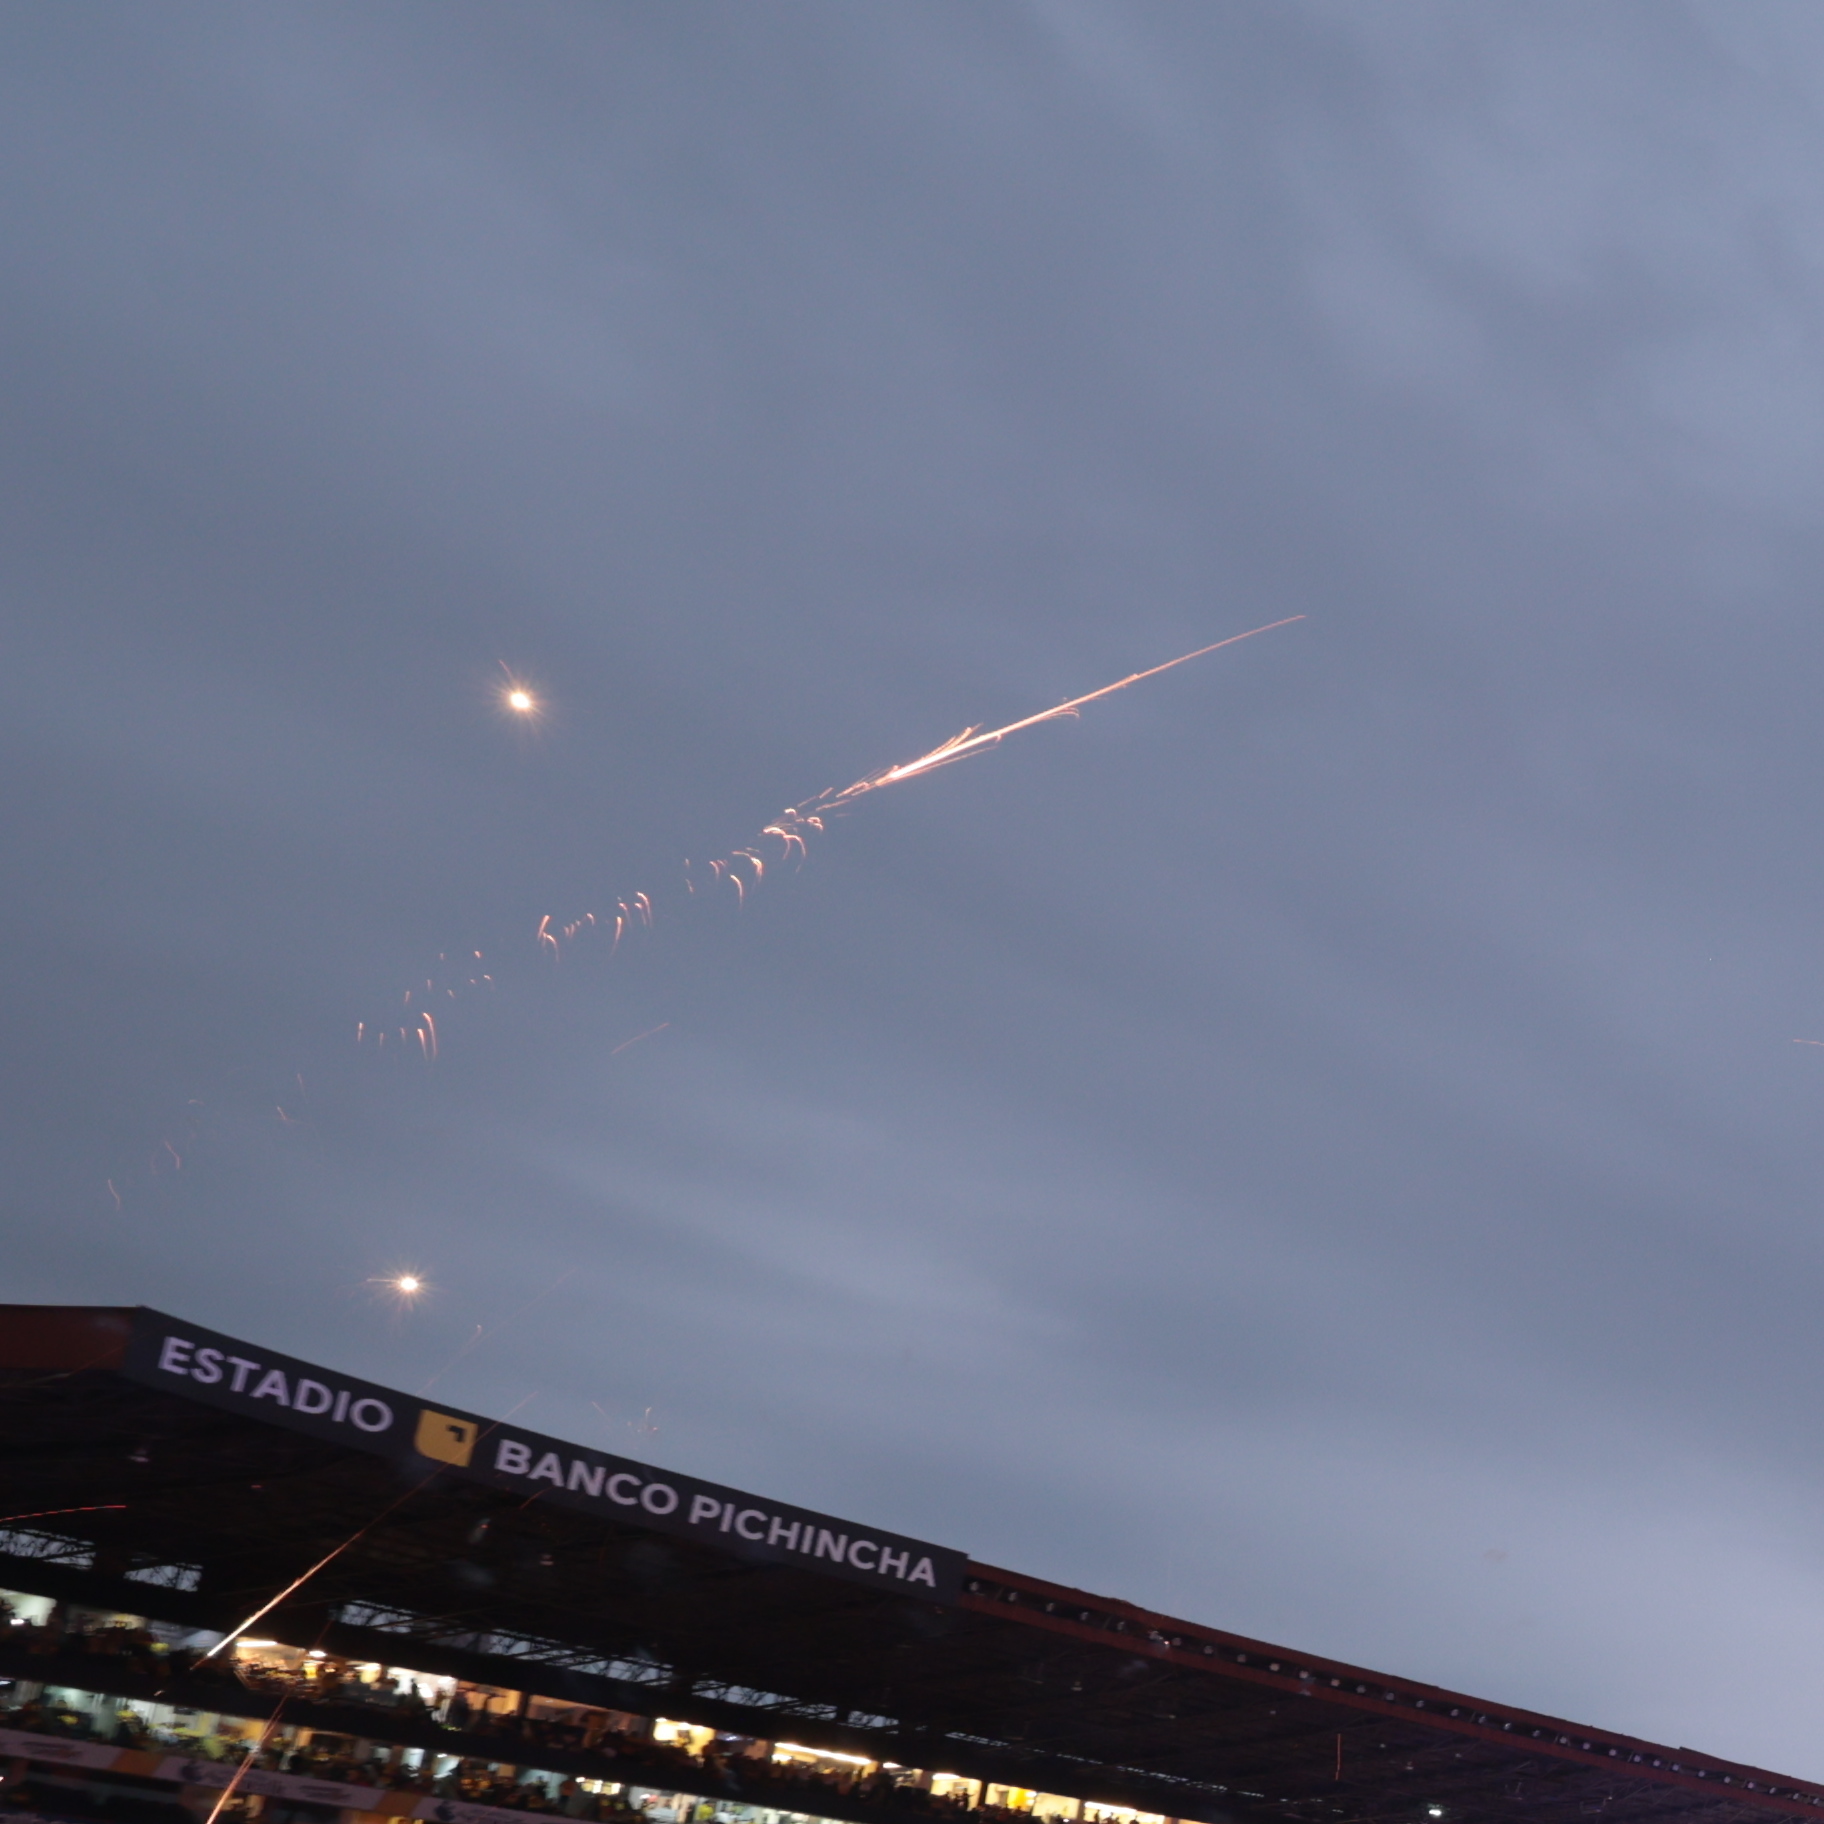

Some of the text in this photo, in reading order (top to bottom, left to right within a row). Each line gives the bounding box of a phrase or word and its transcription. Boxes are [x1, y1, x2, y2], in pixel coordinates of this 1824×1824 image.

[158, 1336, 937, 1588] ESTADIO BANCO PICHINCHA
